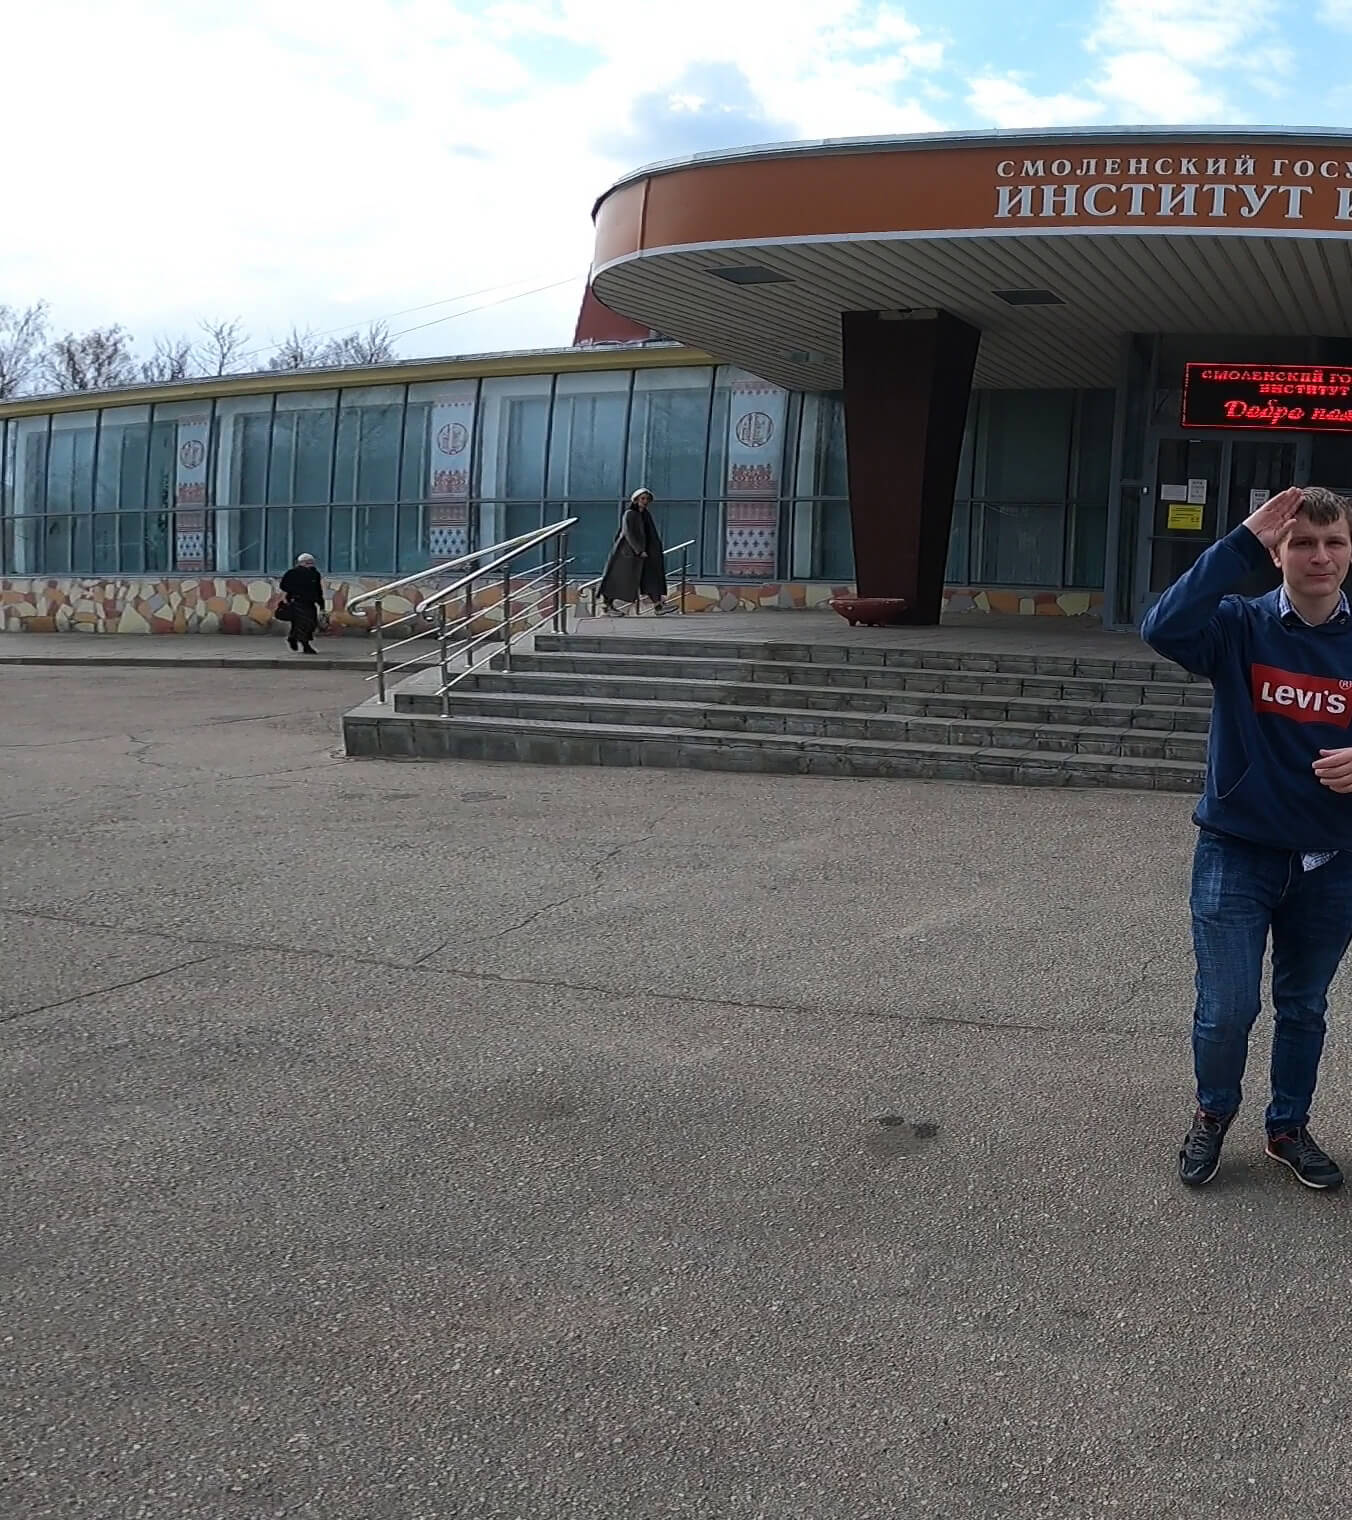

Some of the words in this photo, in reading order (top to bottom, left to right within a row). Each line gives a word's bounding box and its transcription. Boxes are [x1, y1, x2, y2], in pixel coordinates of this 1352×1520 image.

[996, 154, 1258, 178] СМОЛЕНСКИЙ
[994, 182, 1313, 218] ИНСТИТУТ
[1201, 369, 1324, 383] СМОЛЕНСКИЙ
[1258, 383, 1350, 396] ИНСТИТУТ
[1223, 399, 1305, 425] Добро
[1261, 681, 1346, 714] Levi's
